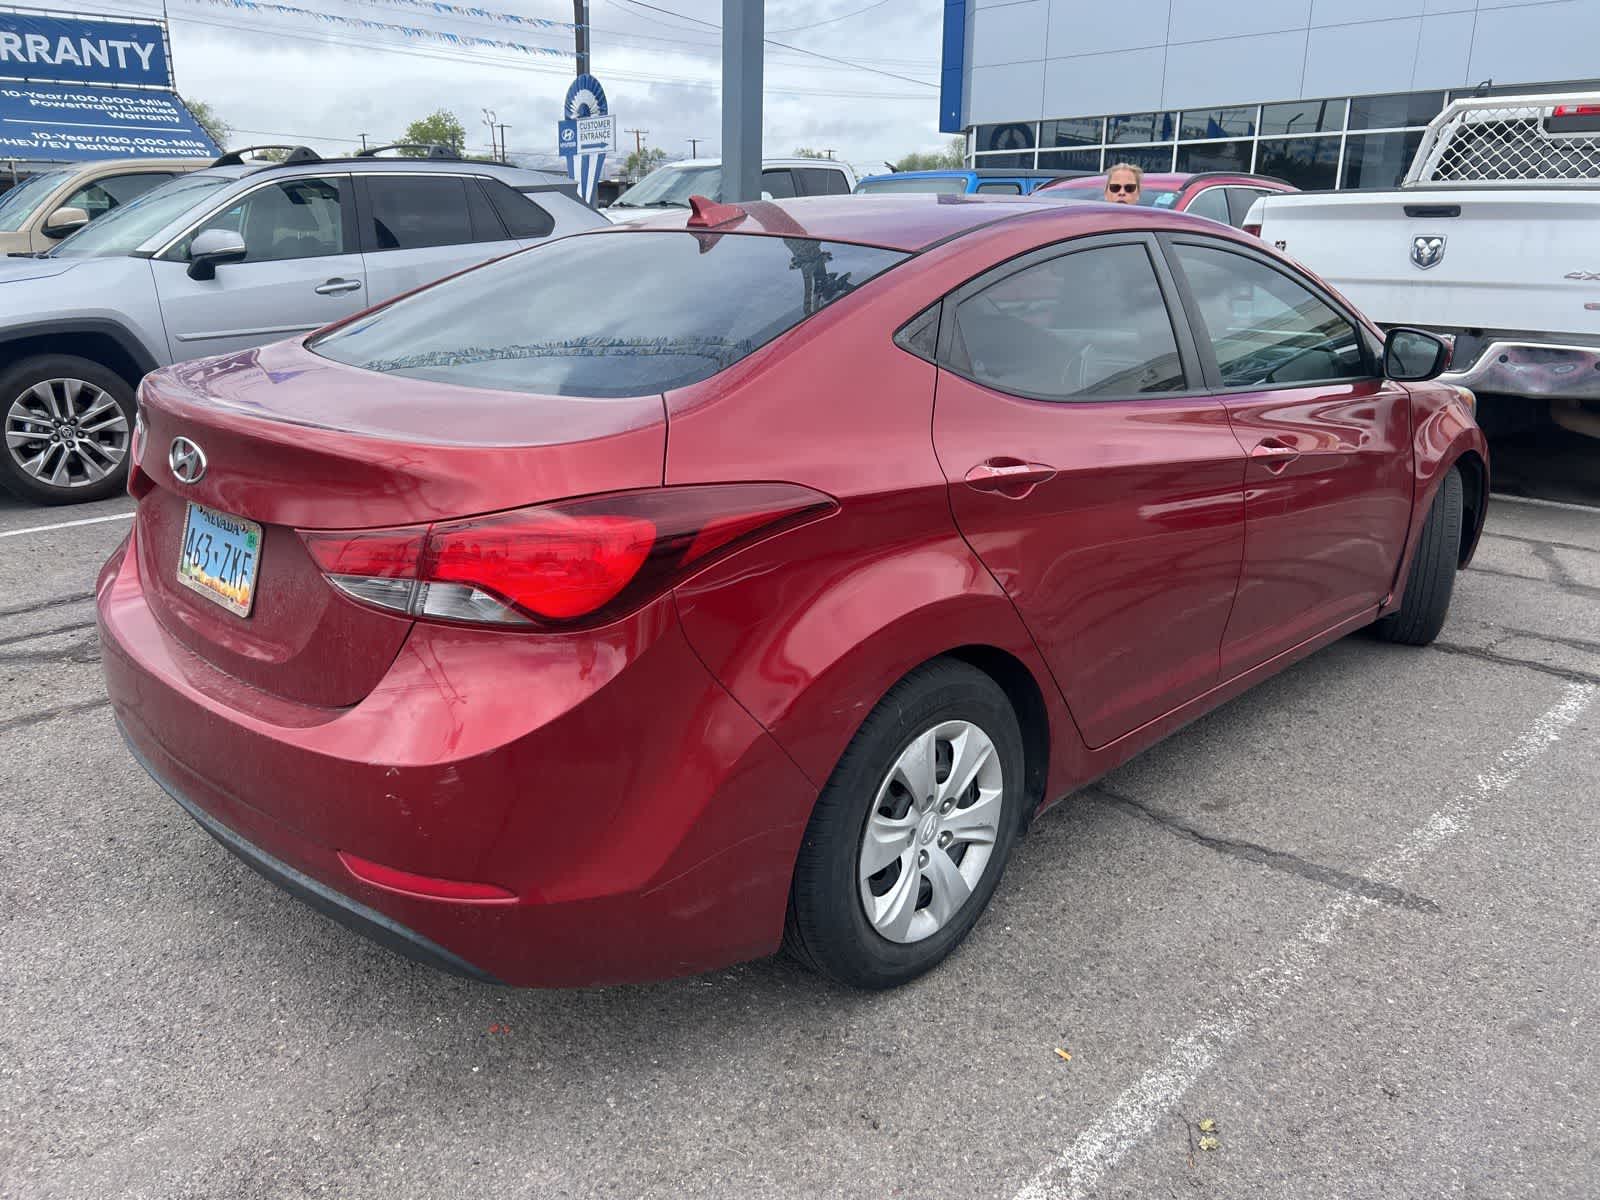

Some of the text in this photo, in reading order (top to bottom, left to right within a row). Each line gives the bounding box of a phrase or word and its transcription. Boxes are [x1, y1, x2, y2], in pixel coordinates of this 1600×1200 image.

[1, 89, 171, 107] 10-Year/100,000-Mile
[29, 99, 178, 115] Powertrain Limited
[107, 111, 180, 123] Warranty
[580, 120, 610, 130] CUSTOMER
[32, 131, 205, 148] 10-Year/100,000-Mile
[580, 131, 610, 141] ENTRANCE
[74, 142, 136, 153] Battery
[137, 145, 211, 157] Warranty
[203, 512, 240, 536] NEVADA
